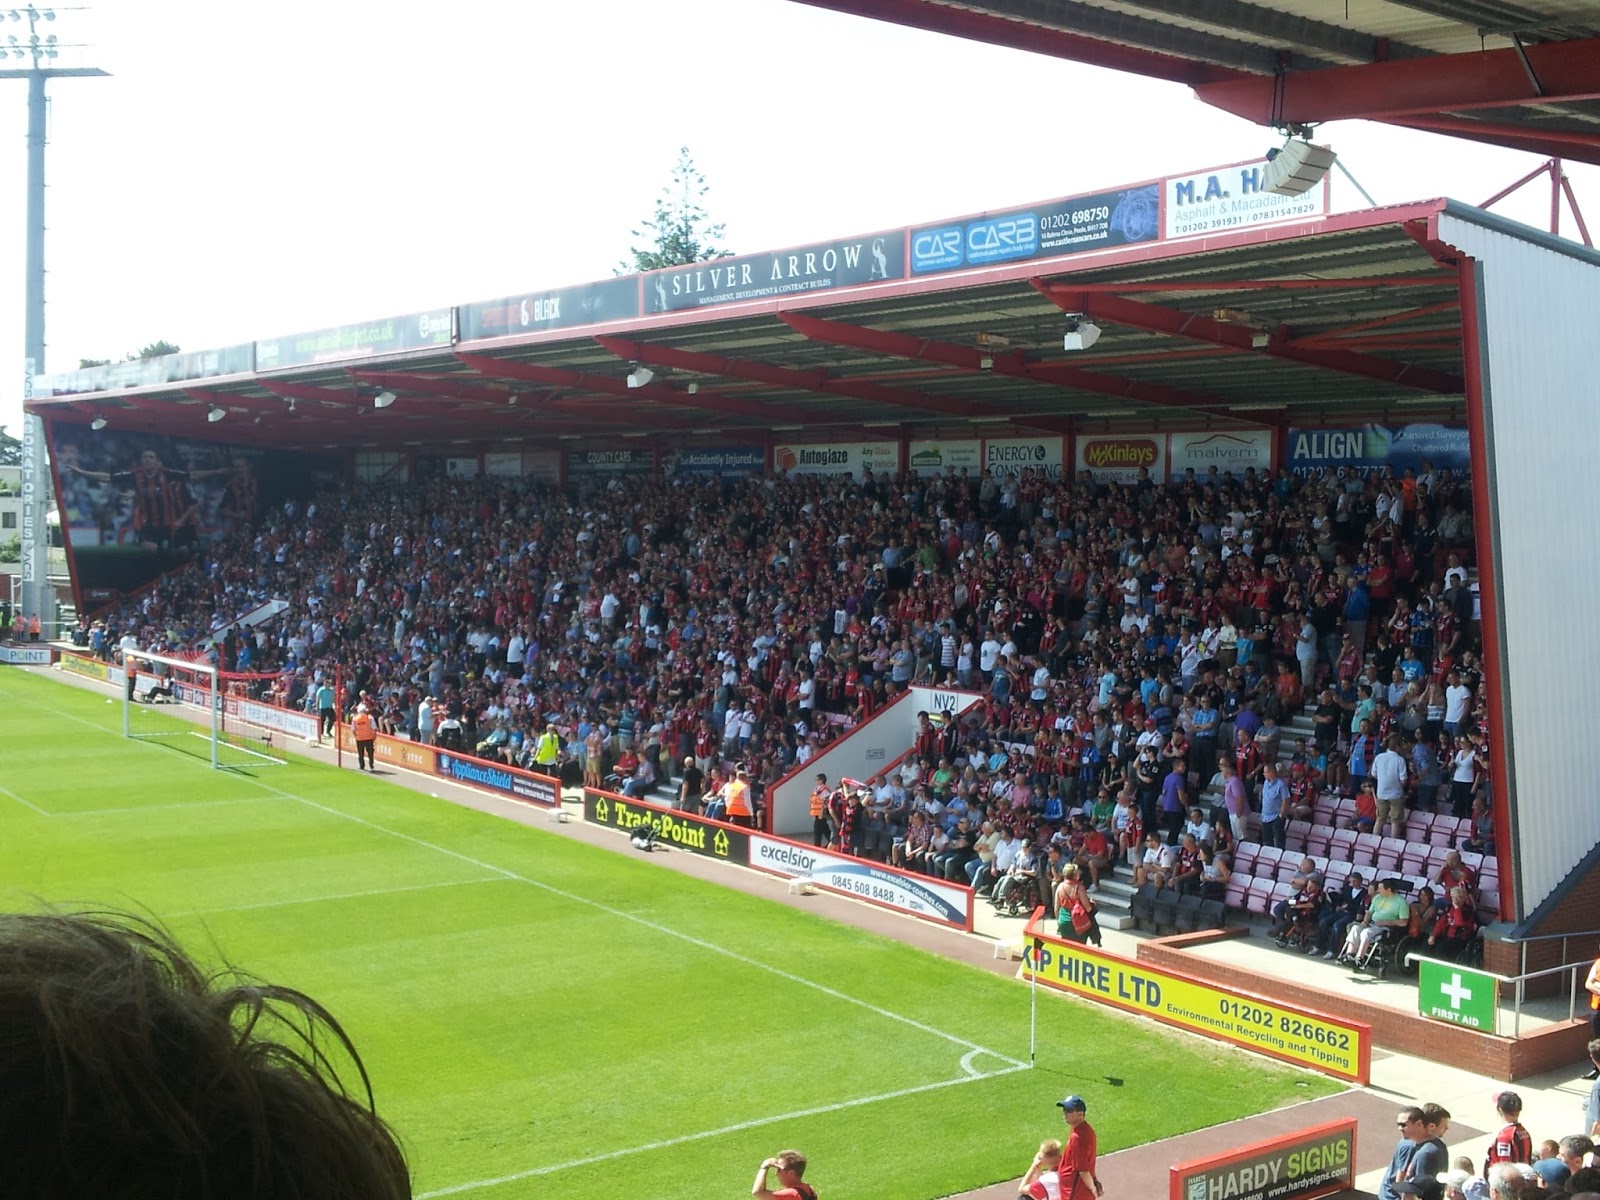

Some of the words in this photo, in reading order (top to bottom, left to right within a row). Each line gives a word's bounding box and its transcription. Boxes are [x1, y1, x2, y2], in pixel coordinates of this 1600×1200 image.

[1176, 175, 1230, 206] M.A.
[1041, 213, 1070, 230] 01202
[1071, 205, 1109, 225] 698750
[1175, 204, 1216, 222] Asphalt
[1220, 201, 1228, 214] &
[1231, 193, 1288, 213] Macadam
[1211, 216, 1243, 228] 391931
[1252, 203, 1315, 222] 07831547829
[914, 230, 961, 259] CAR
[672, 263, 753, 296] SILVER
[770, 244, 863, 281] ARROW
[779, 281, 809, 294] CONTRACT
[810, 277, 832, 290] BUILDS
[534, 297, 561, 322] BLACK
[799, 448, 848, 466] Autoglaze
[988, 445, 1035, 461] ENERGY
[1187, 447, 1258, 458] malvern
[1293, 431, 1363, 459] ALIGN
[725, 453, 752, 467] Injured
[24, 412, 34, 538] ABORATORIES
[10, 650, 45, 661] POINT
[934, 693, 956, 712] NV2
[760, 844, 817, 871] excelsior
[832, 874, 853, 891] 0845
[854, 880, 870, 896] 608
[872, 886, 895, 902] 8488
[1058, 953, 1110, 993] HIRE
[1117, 972, 1161, 1008] LTD
[1219, 999, 1274, 1028] 01202
[1279, 1017, 1350, 1051] 826662
[1432, 1007, 1460, 1021] FIRST
[1462, 1015, 1480, 1027] AID
[1166, 1003, 1234, 1031] Environmental
[1236, 1025, 1284, 1048] Recycling
[1288, 1040, 1307, 1054] and
[1309, 1046, 1349, 1068] Tipping
[1209, 1157, 1283, 1200] HARDY
[1286, 1139, 1348, 1179] SIGNS
[1268, 1165, 1348, 1198] www.hardysigns.com
